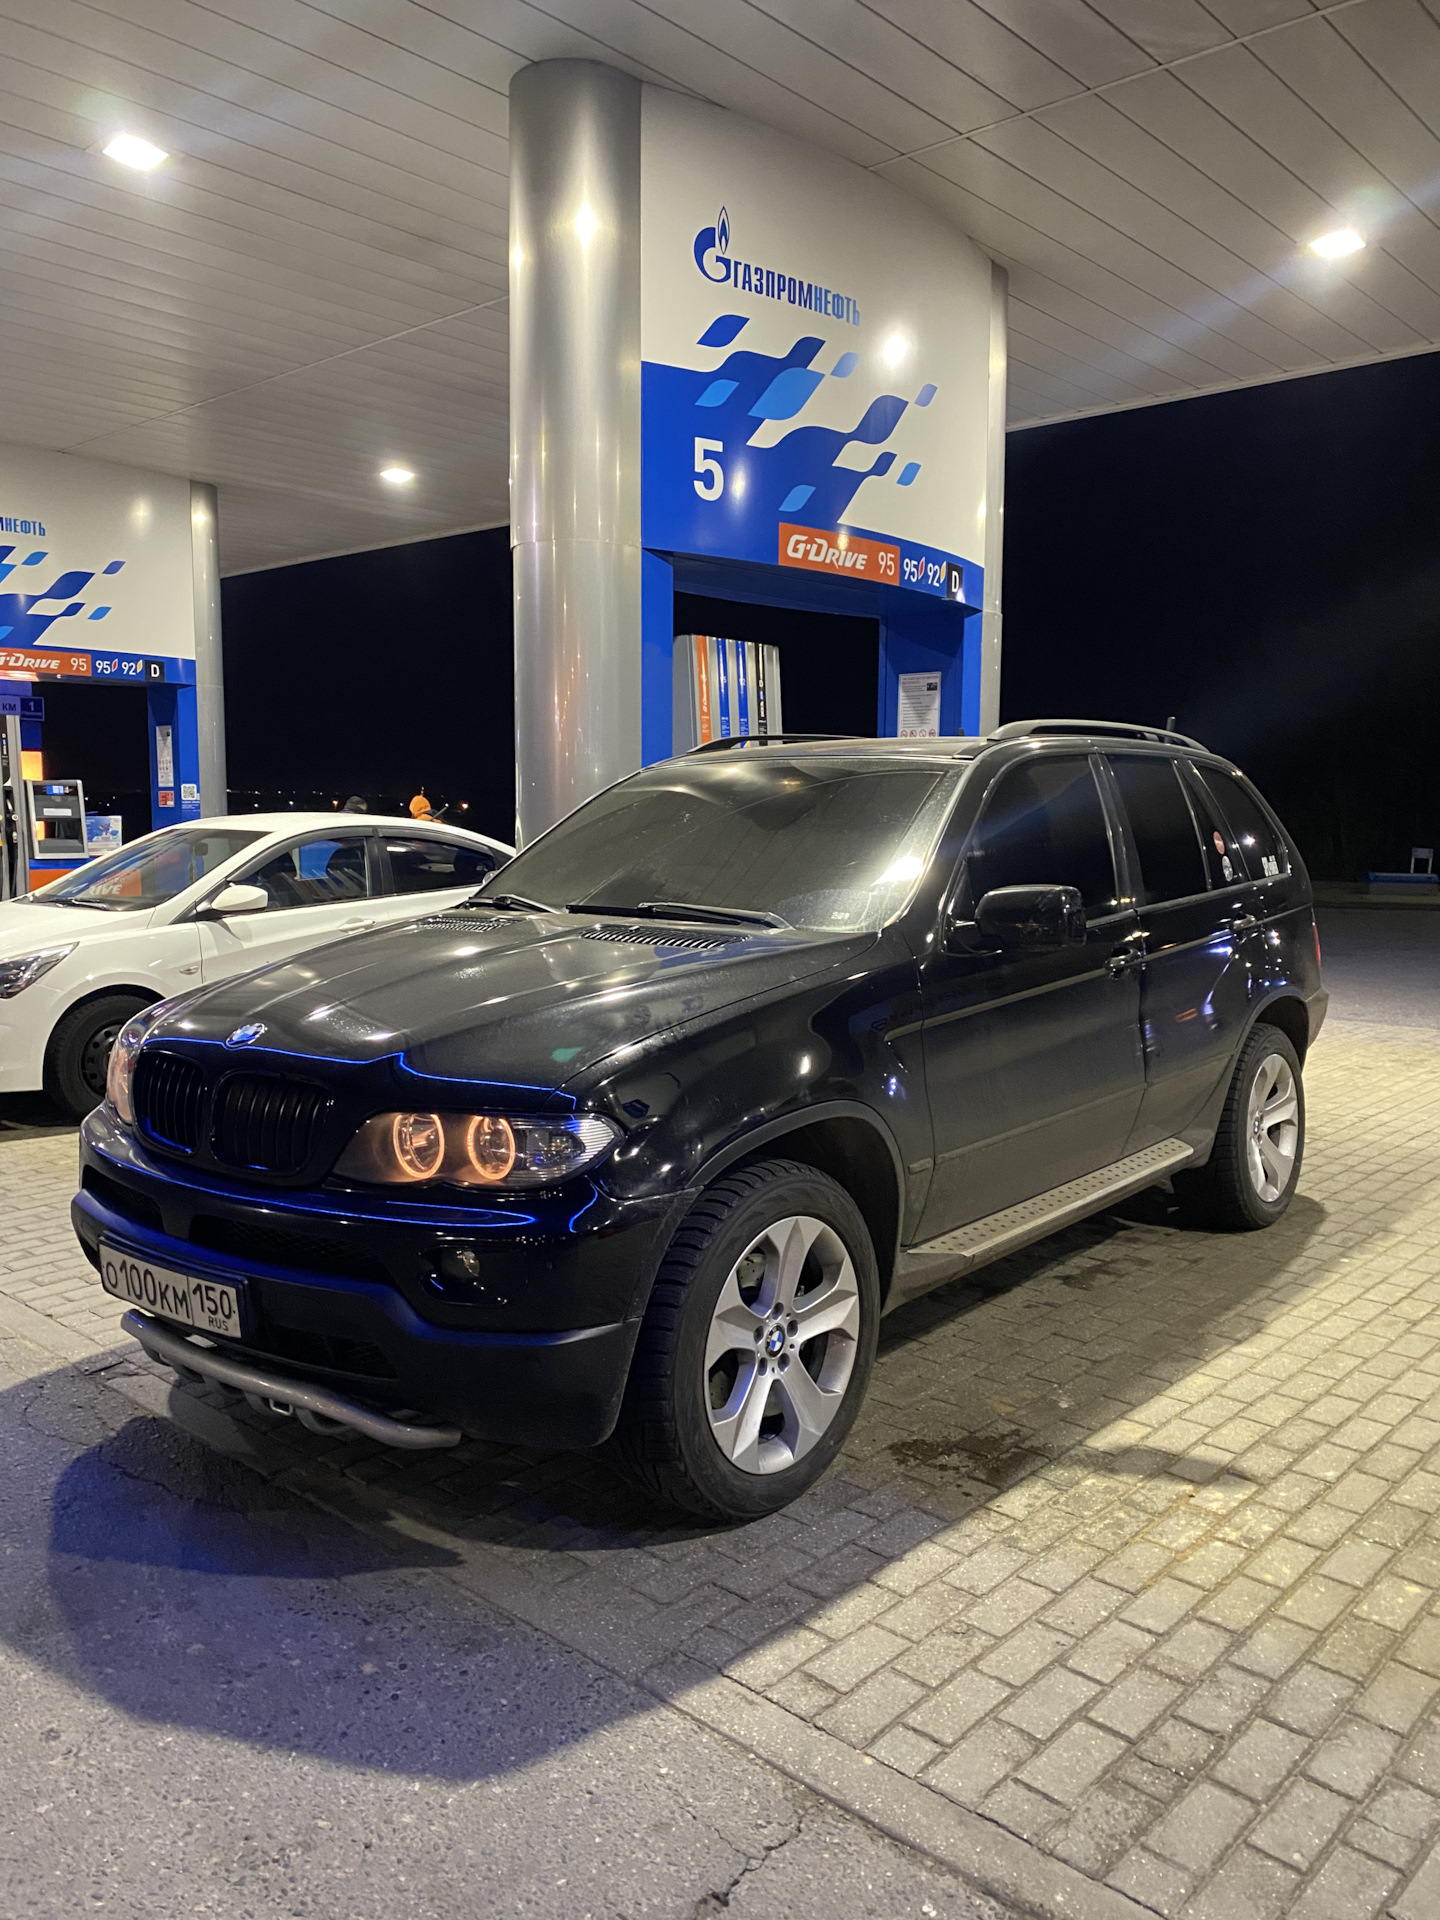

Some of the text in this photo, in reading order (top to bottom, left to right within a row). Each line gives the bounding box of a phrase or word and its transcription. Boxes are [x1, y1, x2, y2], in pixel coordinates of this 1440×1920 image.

[693, 436, 724, 501] 5
[877, 551, 896, 576] 95
[903, 558, 918, 583] 95
[926, 563, 940, 587] 92
[951, 570, 960, 593] D
[70, 658, 87, 671] 95
[95, 660, 111, 674] 95
[121, 661, 136, 676] 92
[150, 664, 160, 678] D
[208, 1315, 229, 1332] RUS
